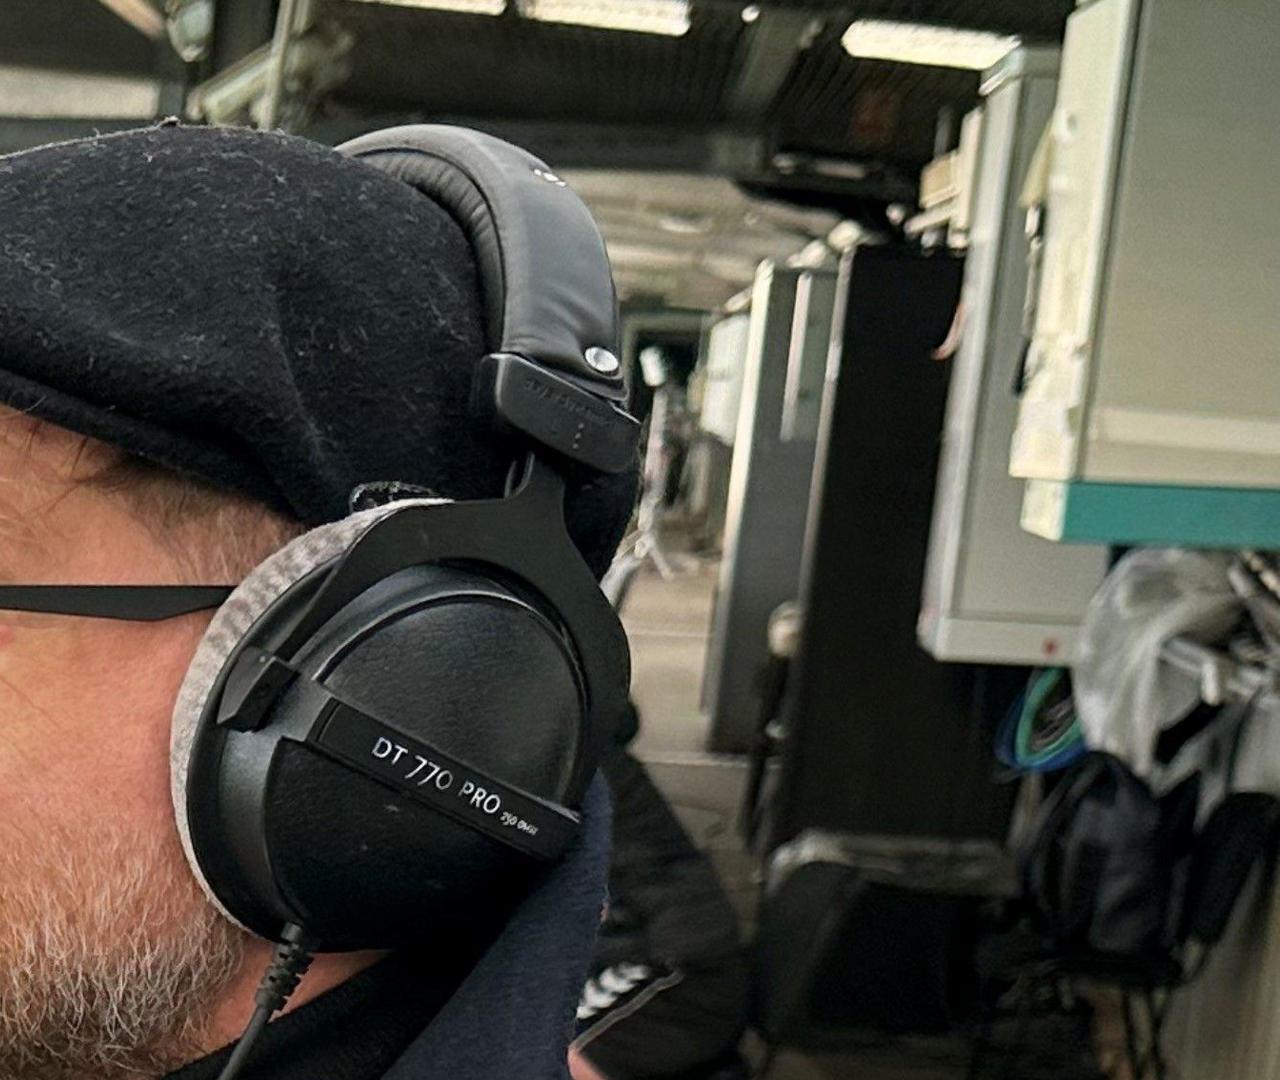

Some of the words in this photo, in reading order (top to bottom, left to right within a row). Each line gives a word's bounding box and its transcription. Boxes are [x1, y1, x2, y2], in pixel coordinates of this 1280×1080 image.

[371, 736, 409, 765] DT
[404, 754, 454, 790] 770
[458, 780, 501, 814] PRO
